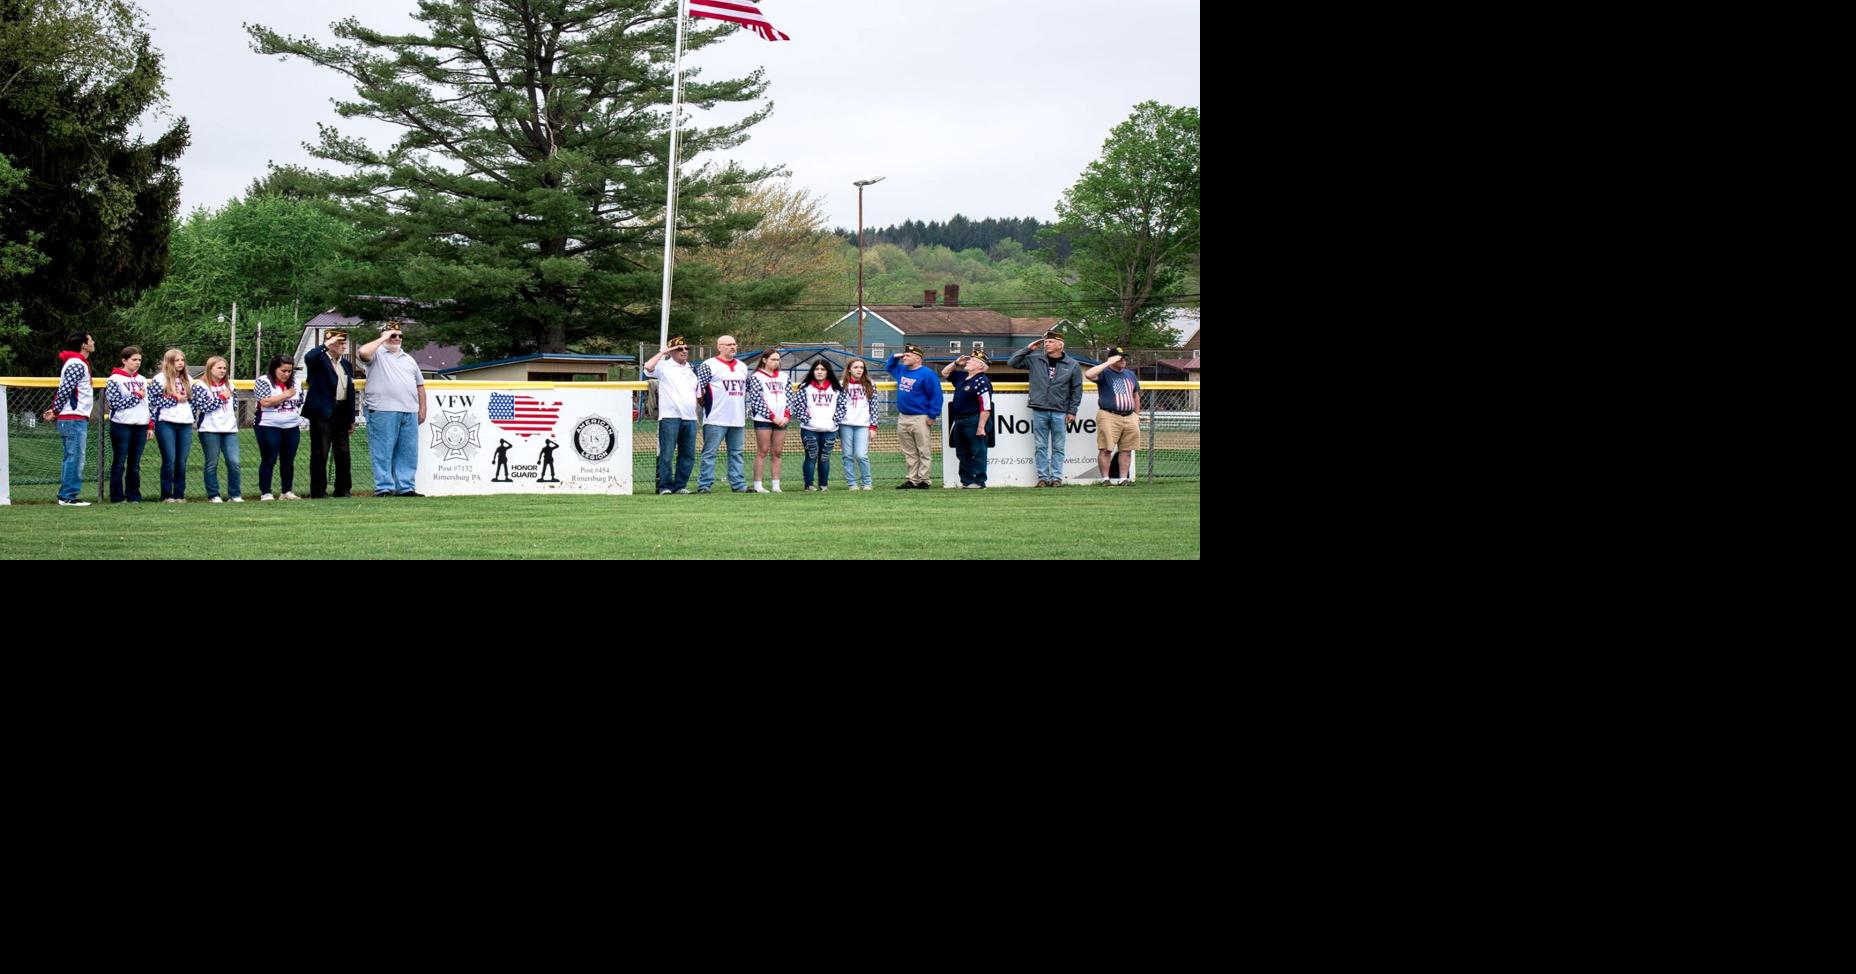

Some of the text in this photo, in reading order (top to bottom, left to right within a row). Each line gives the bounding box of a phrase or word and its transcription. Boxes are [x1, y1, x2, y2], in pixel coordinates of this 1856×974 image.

[765, 382, 785, 391] VFW
[435, 395, 475, 408] VFW
[812, 394, 834, 403] VFW
[576, 419, 614, 434] AMERICAN
[581, 451, 608, 460] LEGION
[433, 473, 470, 482] Rimersburg
[571, 475, 606, 483] Rimersburg
